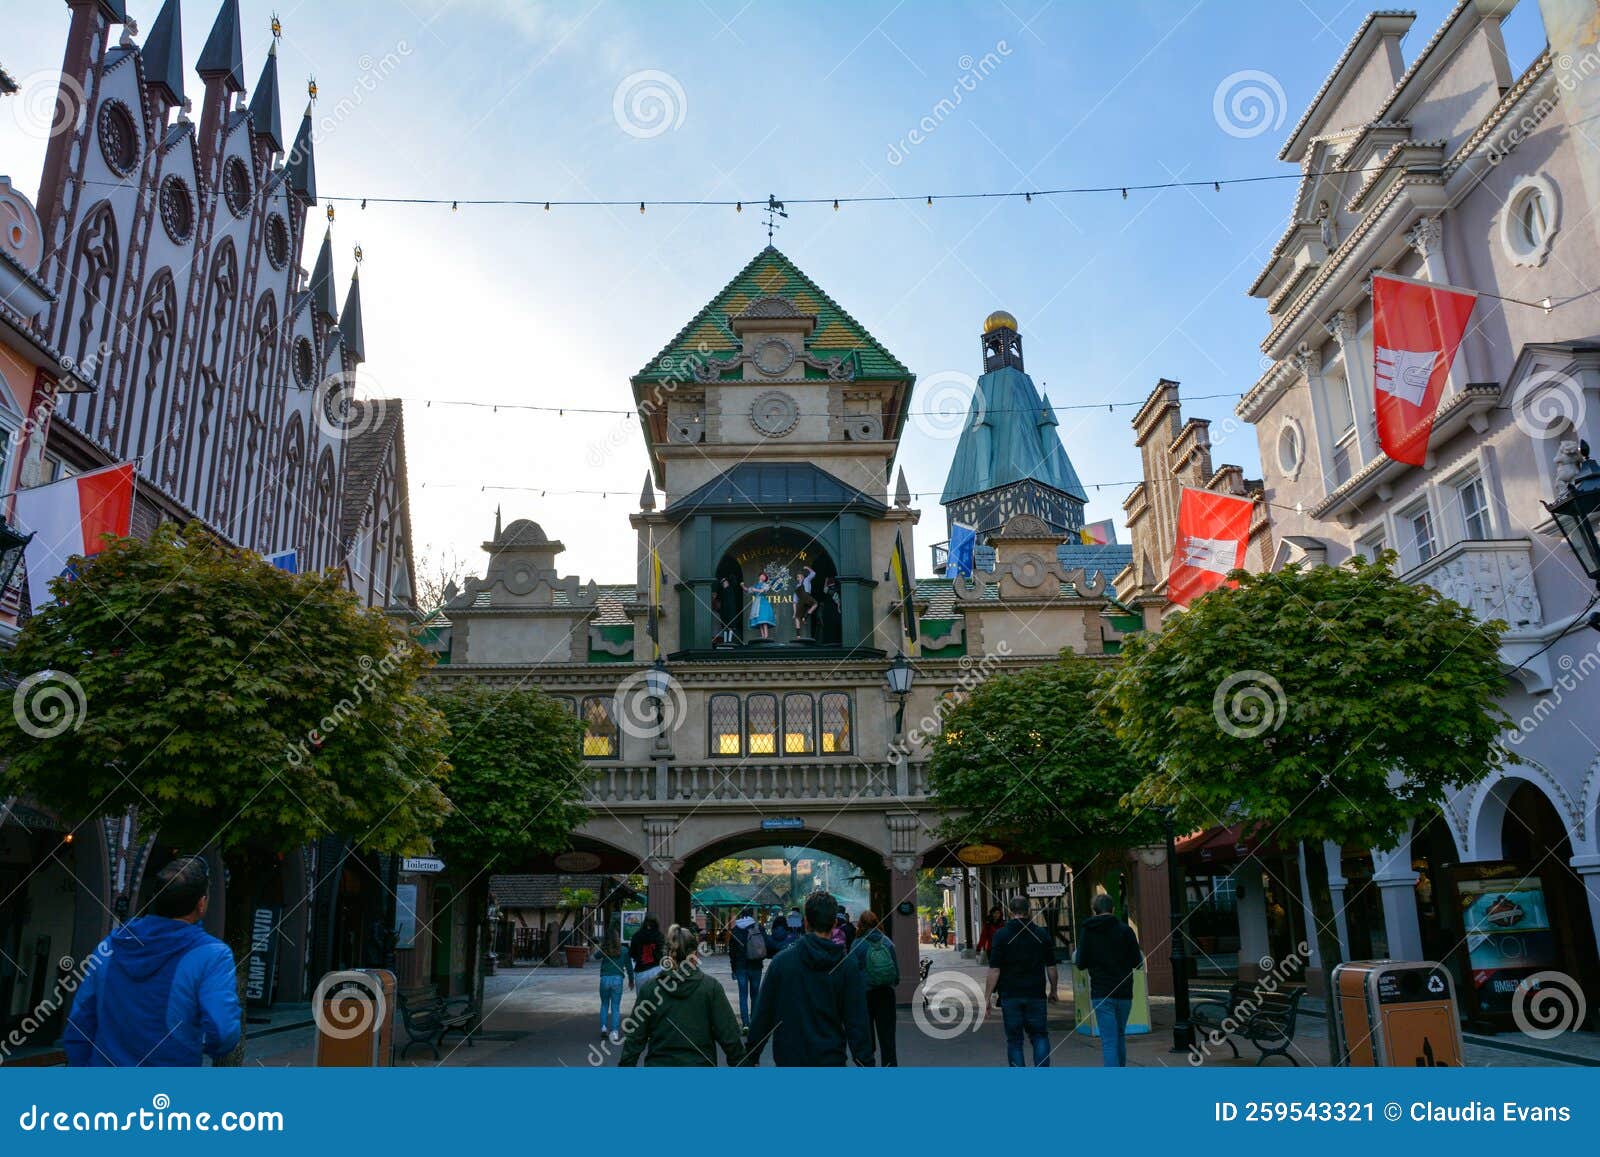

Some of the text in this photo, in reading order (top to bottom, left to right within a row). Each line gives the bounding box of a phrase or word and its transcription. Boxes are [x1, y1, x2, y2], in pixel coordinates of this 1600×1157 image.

[405, 860, 439, 870] Toiletten
[246, 908, 273, 999] CAMP DAVID
